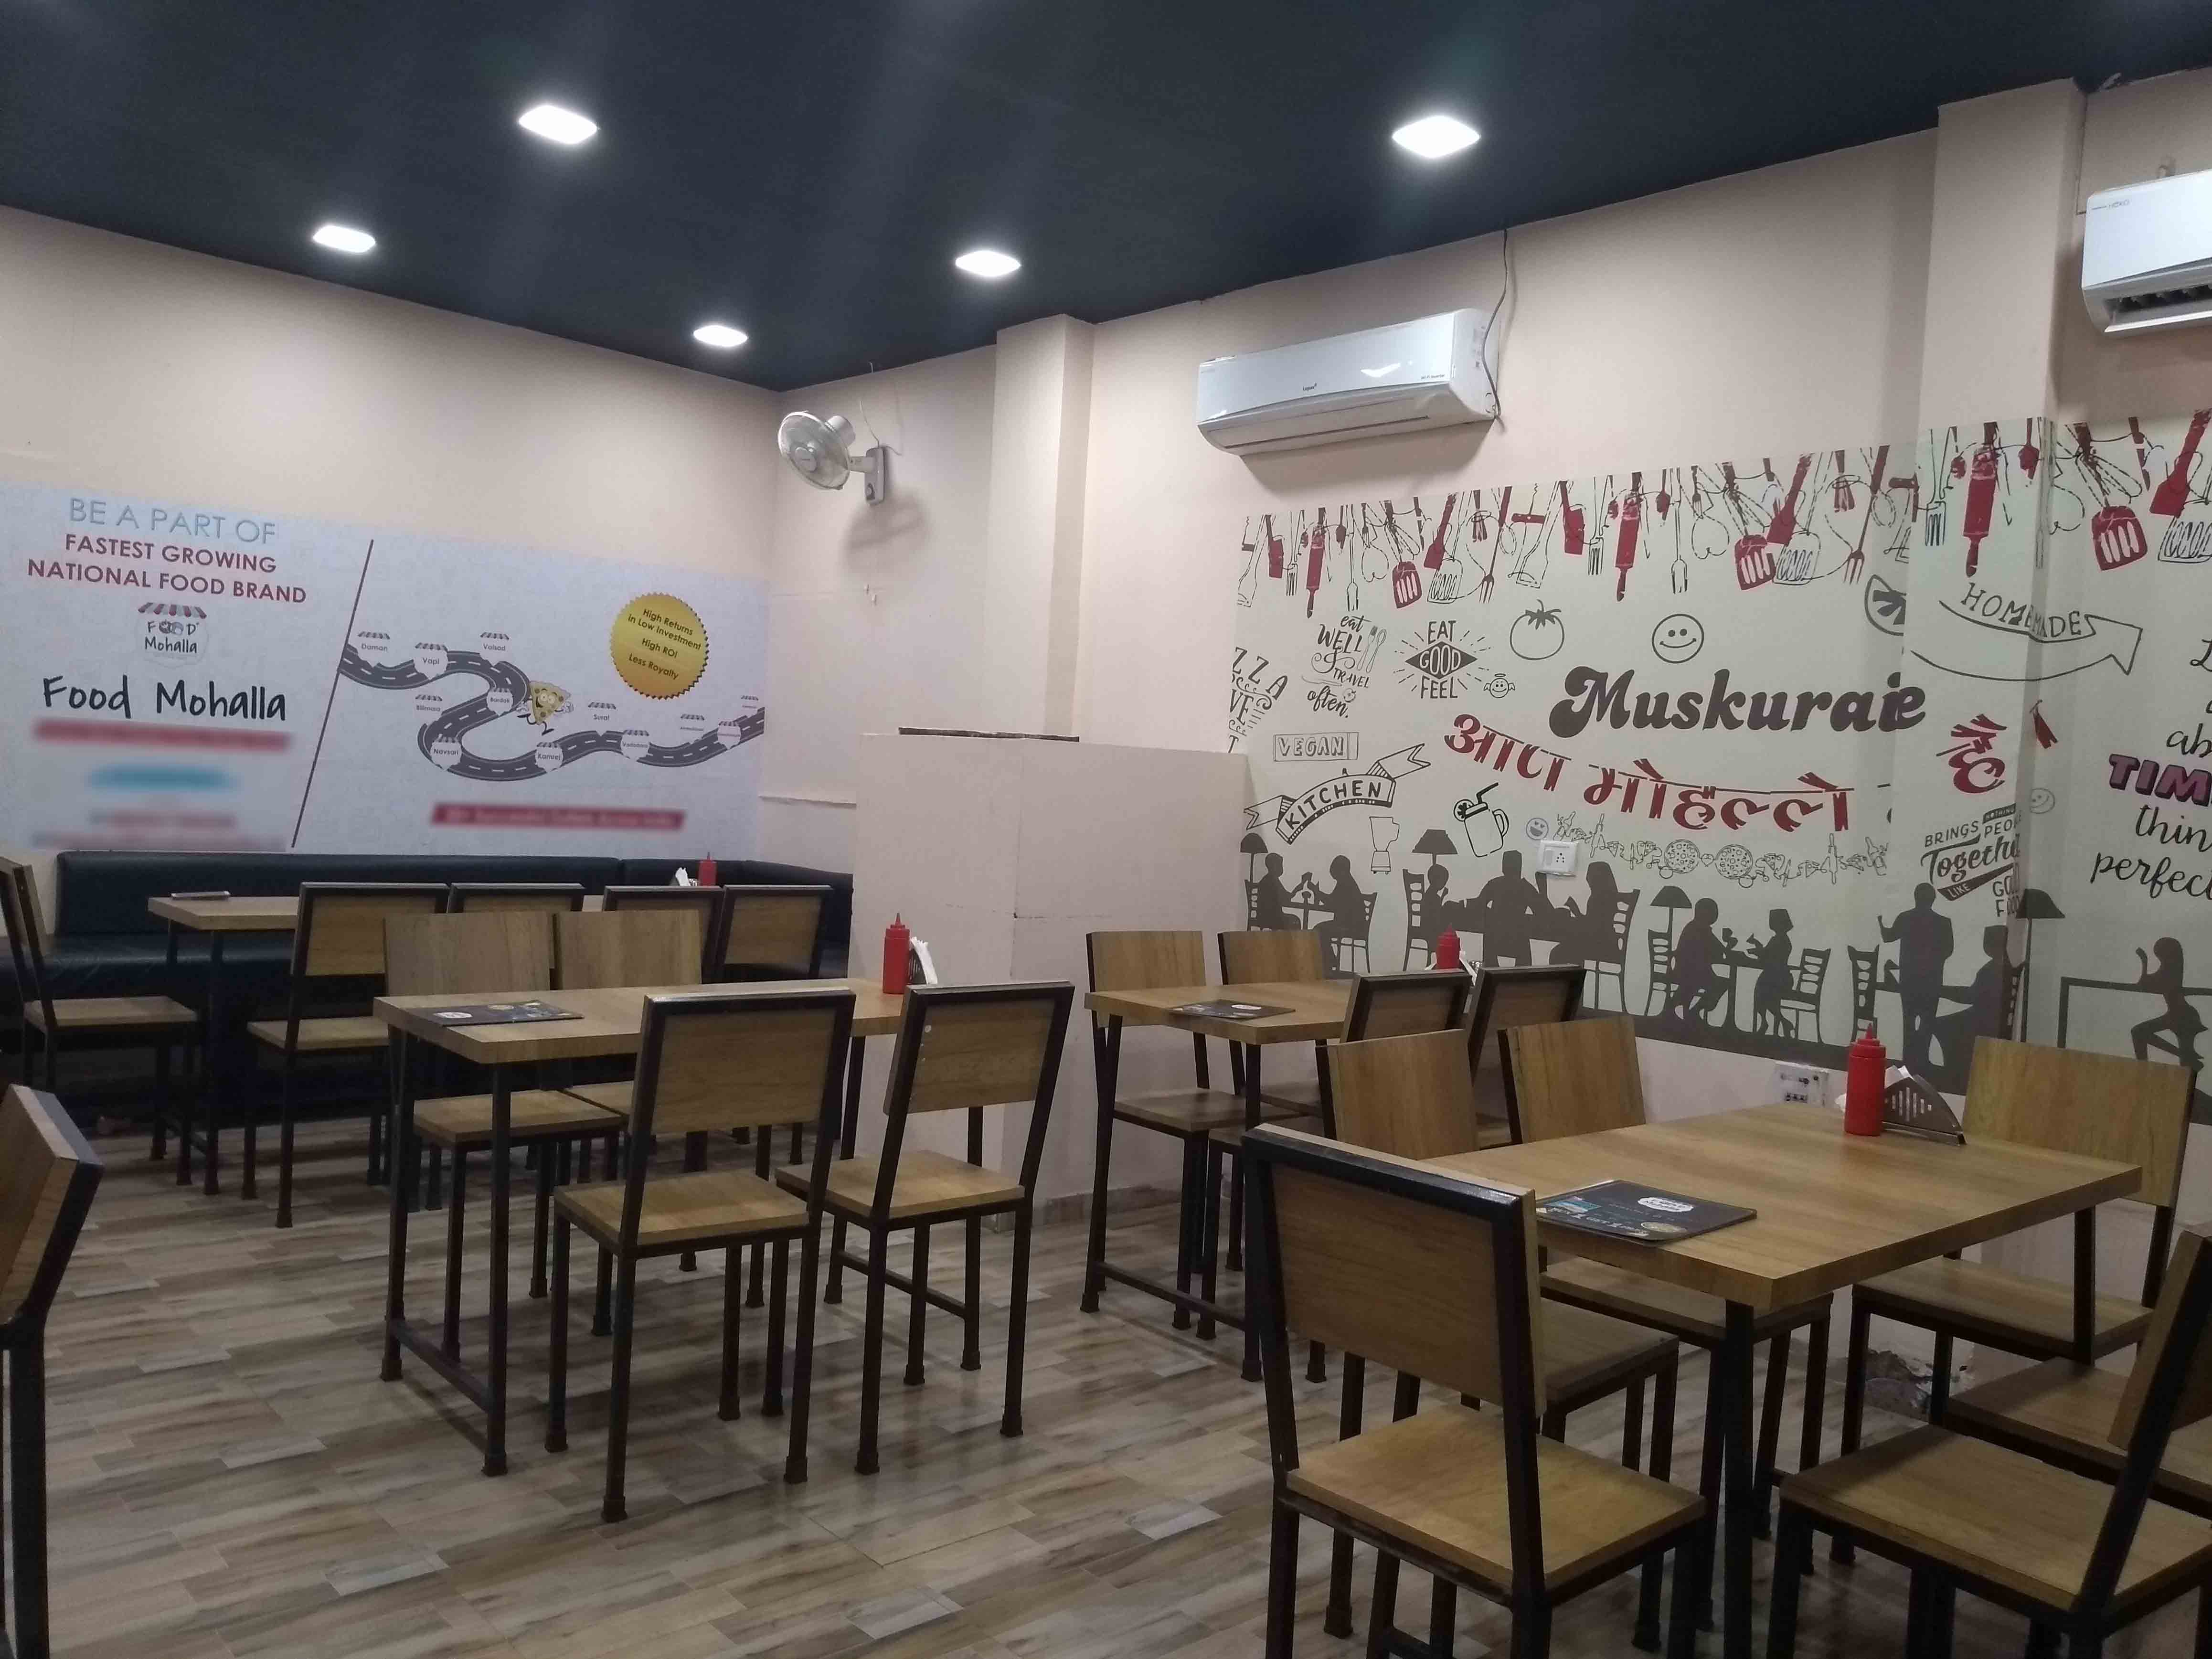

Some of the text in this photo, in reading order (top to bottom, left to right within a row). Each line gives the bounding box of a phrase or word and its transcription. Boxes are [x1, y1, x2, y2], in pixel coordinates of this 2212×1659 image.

[70, 497, 276, 544] BE A PART OF
[65, 533, 276, 573] FASTEST GROWING
[28, 558, 306, 603] NATIONAL FOOD BRAND
[628, 614, 702, 650] In Low Investment
[643, 608, 693, 636] High Returns
[1340, 615, 1372, 632] eat
[1427, 620, 1456, 645] EAT
[145, 636, 197, 654] Mohalla
[642, 638, 678, 659] High ROI
[1318, 624, 1362, 654] WELL
[629, 653, 679, 680] Less Royalty
[1419, 644, 1461, 677] GOOD
[1333, 667, 1370, 688] TRAVEL
[1421, 676, 1457, 699] FEEL
[43, 675, 286, 721] Food Mohalla
[1278, 736, 1345, 757] VEGAN
[1444, 713, 1573, 791] आप
[2166, 723, 2212, 758] ab
[2109, 754, 2212, 807] TIM
[1286, 780, 1382, 830] KITCHEN
[1925, 820, 1978, 847] BRINGS
[2136, 804, 2212, 852] thin
[1947, 883, 1971, 898] LIKE
